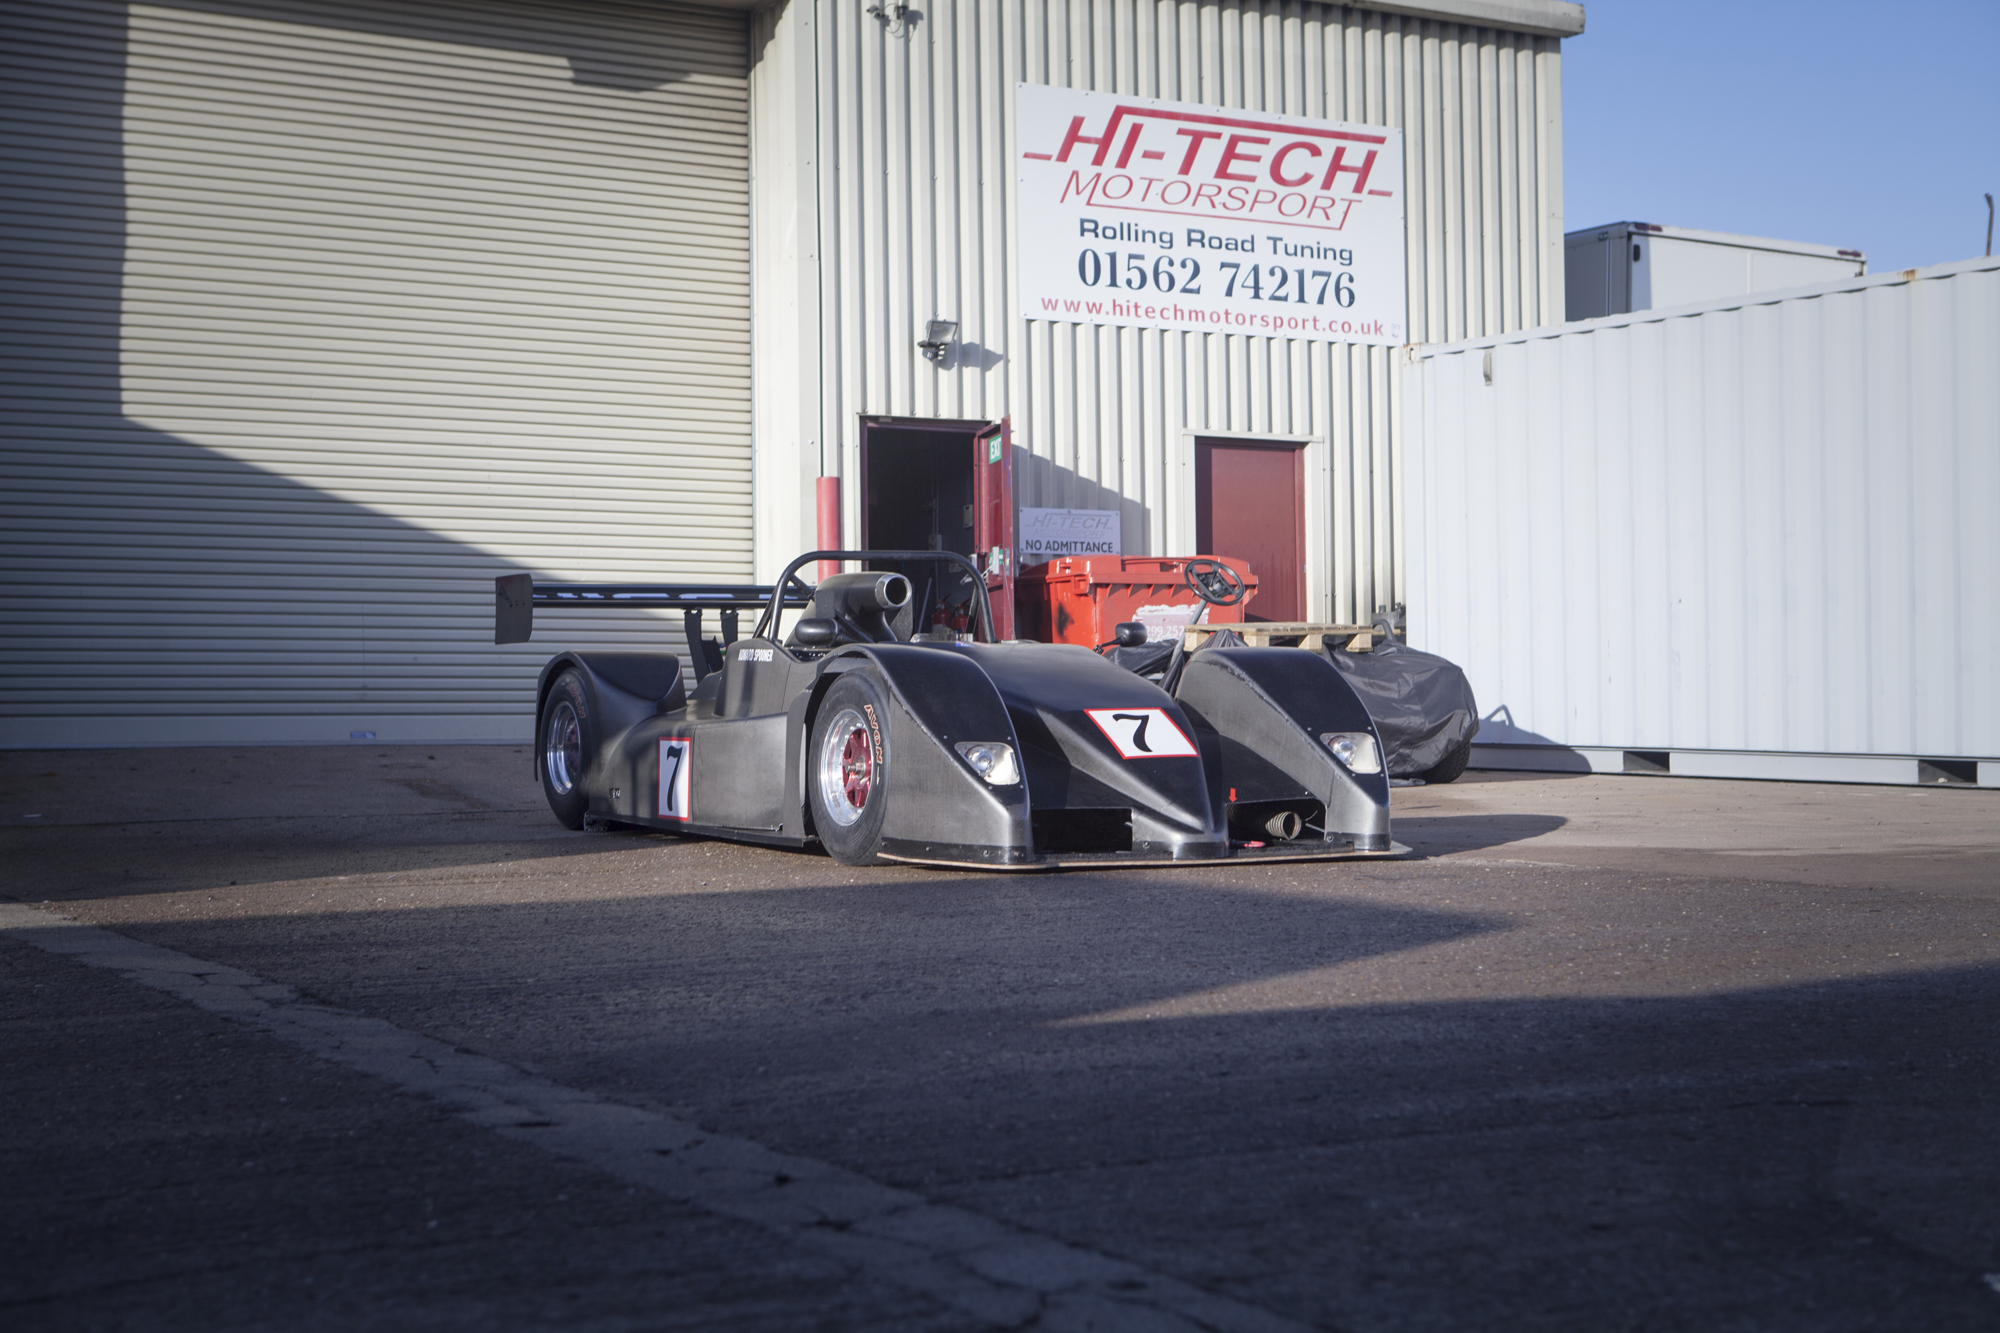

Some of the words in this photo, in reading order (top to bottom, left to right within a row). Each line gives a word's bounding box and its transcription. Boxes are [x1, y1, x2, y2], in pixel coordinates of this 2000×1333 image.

[1054, 105, 1387, 196] HI-TECH
[1059, 170, 1363, 231] MOTORSPORT
[1079, 218, 1174, 250] Rolling
[1186, 228, 1256, 253] Road
[1266, 236, 1354, 266] Tuning
[1077, 248, 1202, 295] 01562
[1218, 261, 1356, 309] 742176
[1040, 297, 1385, 337] www.hitechmotorsport.co.uk
[1032, 512, 1111, 530] HI-TECH
[1033, 528, 1106, 539] MOTORSPORT
[1025, 539, 1042, 551] NO
[1045, 540, 1114, 554] ADMITTANCE
[565, 682, 586, 719] AVON
[863, 703, 883, 765] AVON
[1111, 713, 1154, 753] 7
[666, 745, 683, 812] 7
